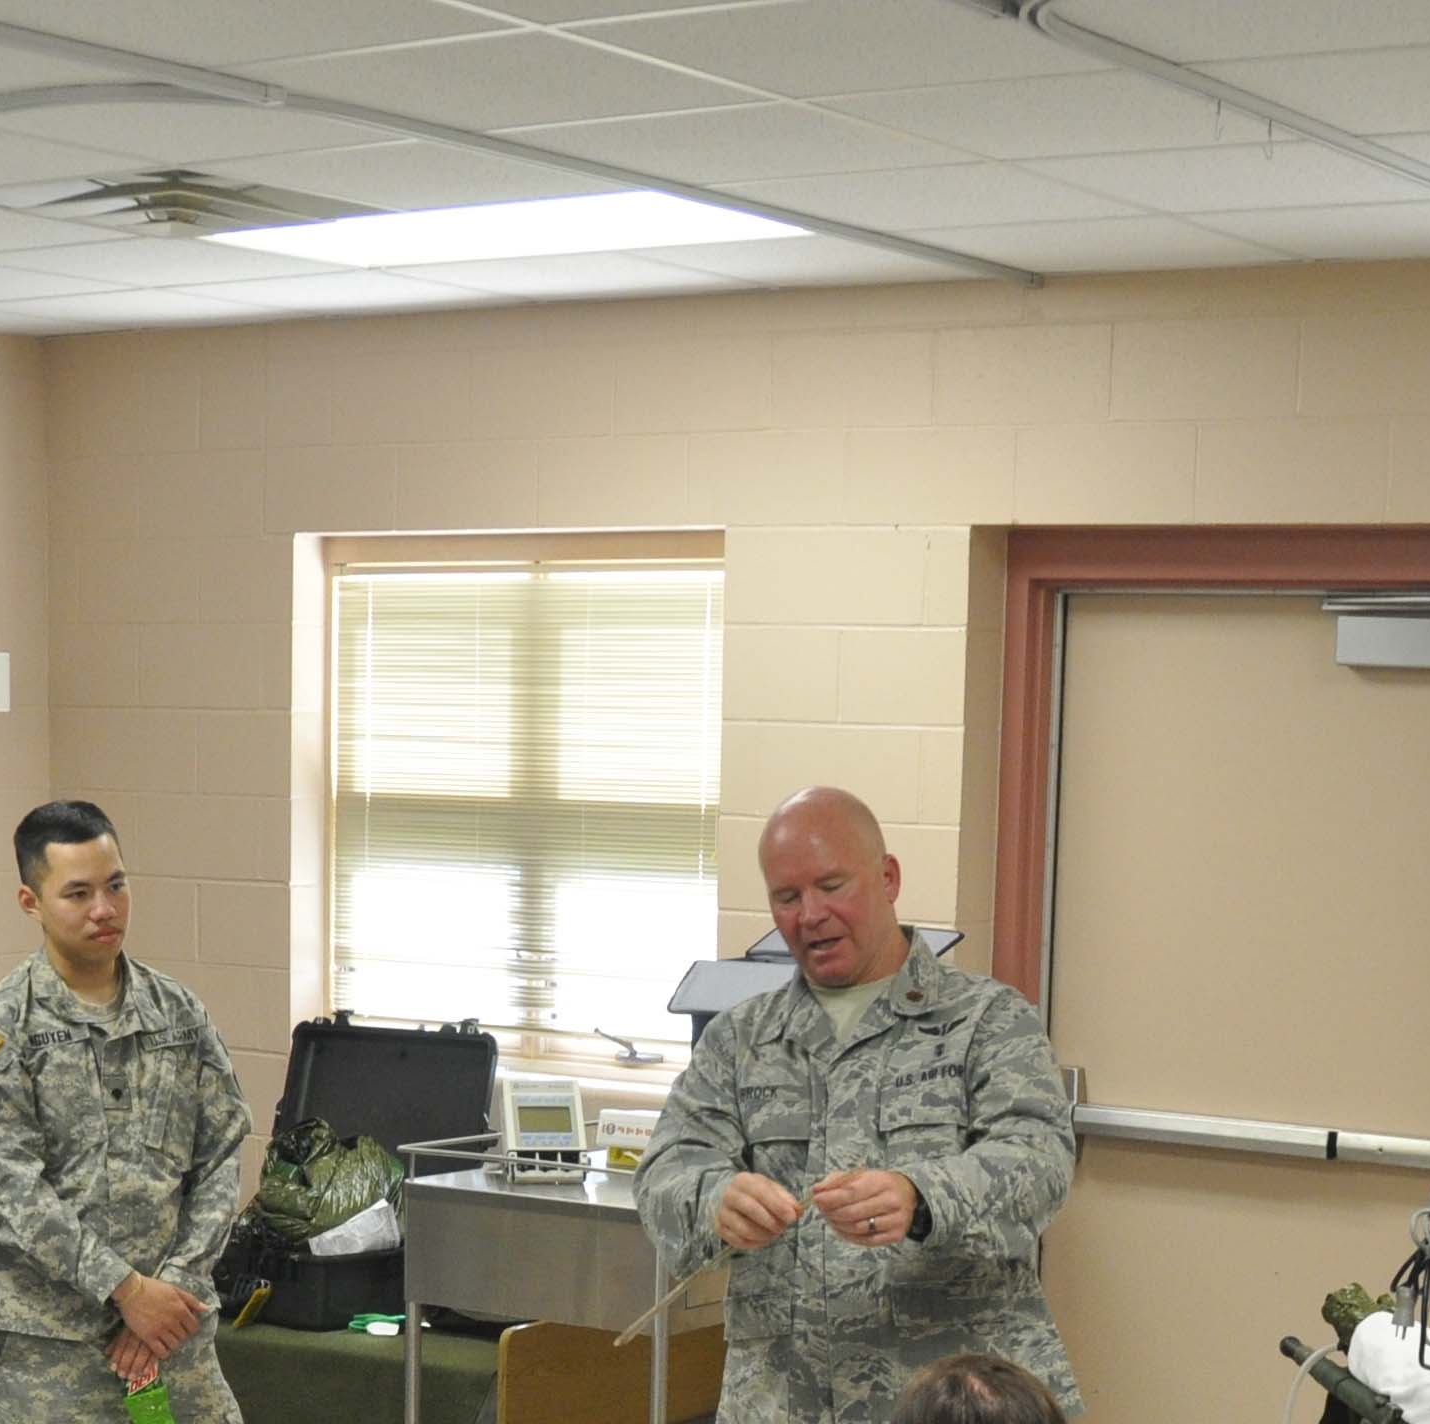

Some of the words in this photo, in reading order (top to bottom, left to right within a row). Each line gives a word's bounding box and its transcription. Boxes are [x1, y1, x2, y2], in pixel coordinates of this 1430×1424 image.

[28, 1029, 72, 1047] NGUYEN
[172, 1028, 200, 1042] ARMY
[896, 1074, 915, 1087] U.S.
[921, 1068, 938, 1081] AIR
